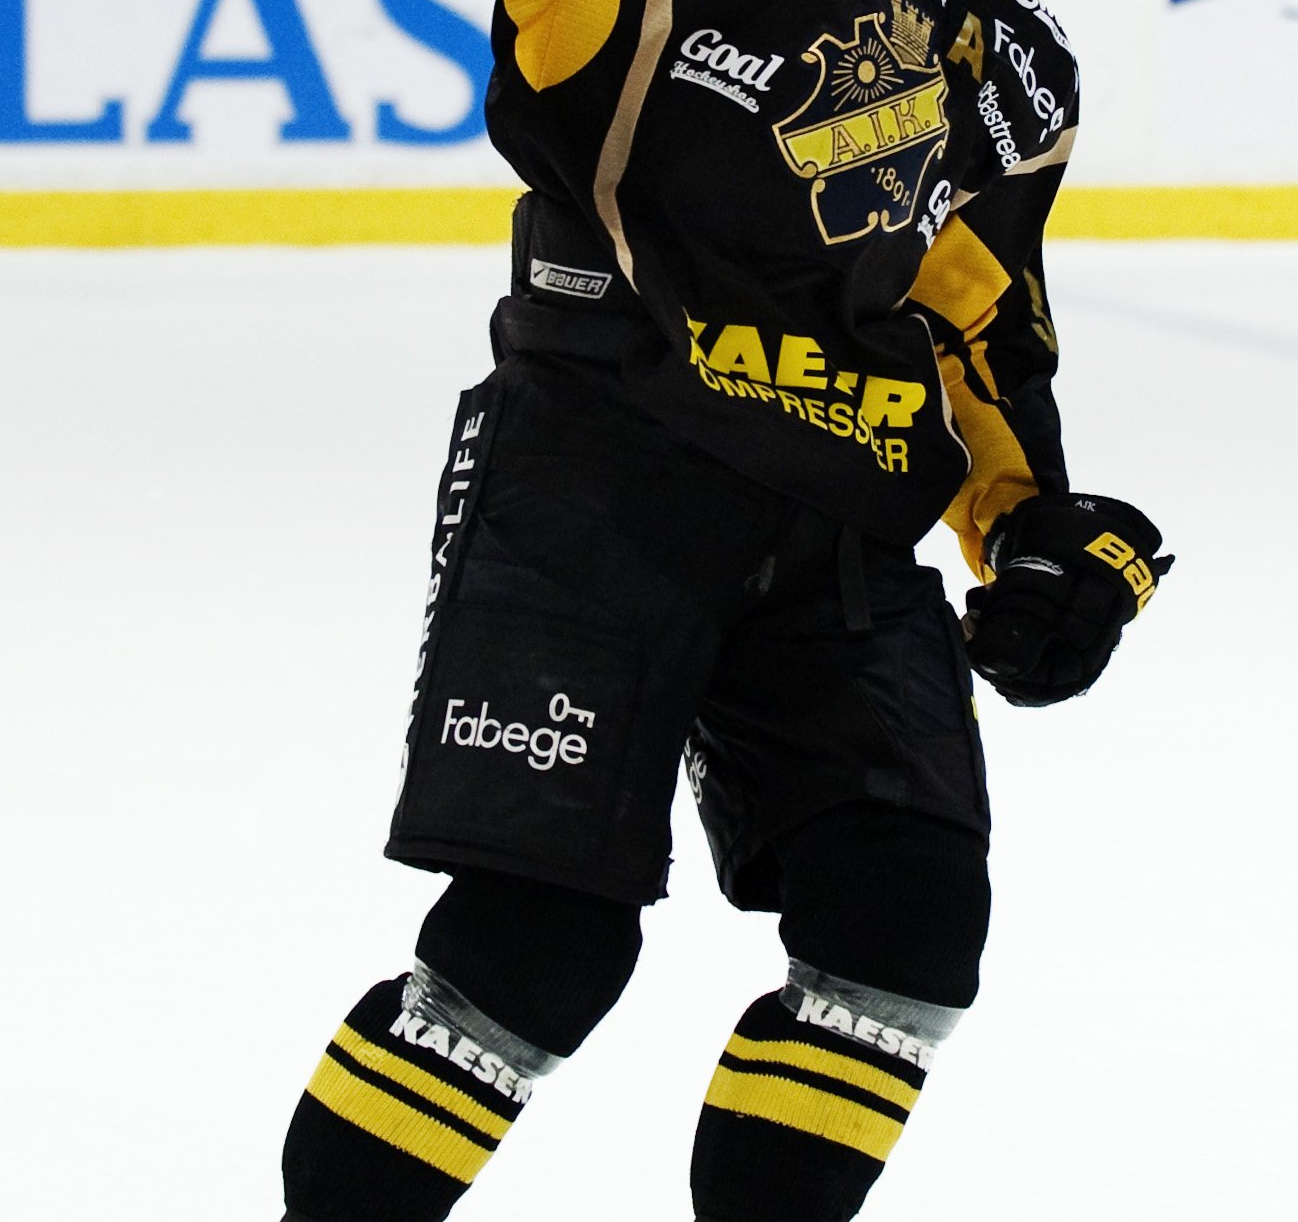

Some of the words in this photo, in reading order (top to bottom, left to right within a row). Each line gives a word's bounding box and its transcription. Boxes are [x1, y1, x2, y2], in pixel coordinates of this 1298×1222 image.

[680, 29, 785, 92] Goal
[1075, 499, 1096, 512] AIK
[441, 699, 588, 771] Fabege
